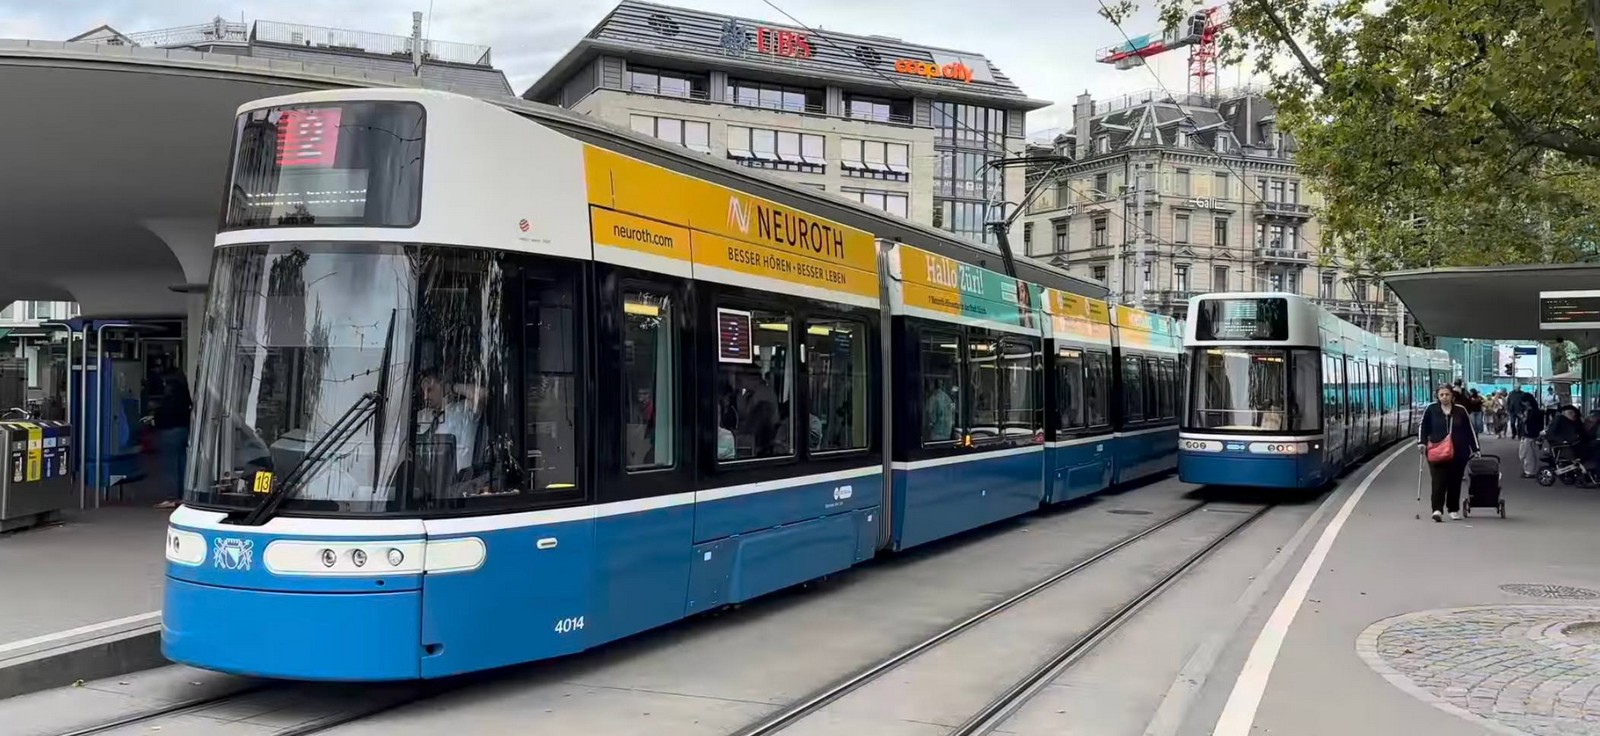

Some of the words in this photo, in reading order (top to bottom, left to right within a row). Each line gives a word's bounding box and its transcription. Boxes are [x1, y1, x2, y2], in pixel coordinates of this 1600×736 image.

[756, 26, 811, 58] UBS
[894, 59, 940, 79] coop
[942, 62, 973, 84] city
[613, 224, 674, 249] neuroth.com
[757, 205, 844, 260] NEUROTH
[728, 246, 761, 267] BESSER
[763, 254, 792, 273] HÖREN
[797, 263, 824, 280] BESSER
[825, 269, 846, 285] LEBEN
[925, 255, 957, 289] Hallo
[959, 264, 985, 295] Züri!
[256, 474, 270, 491] 13
[554, 615, 585, 634] 4014
